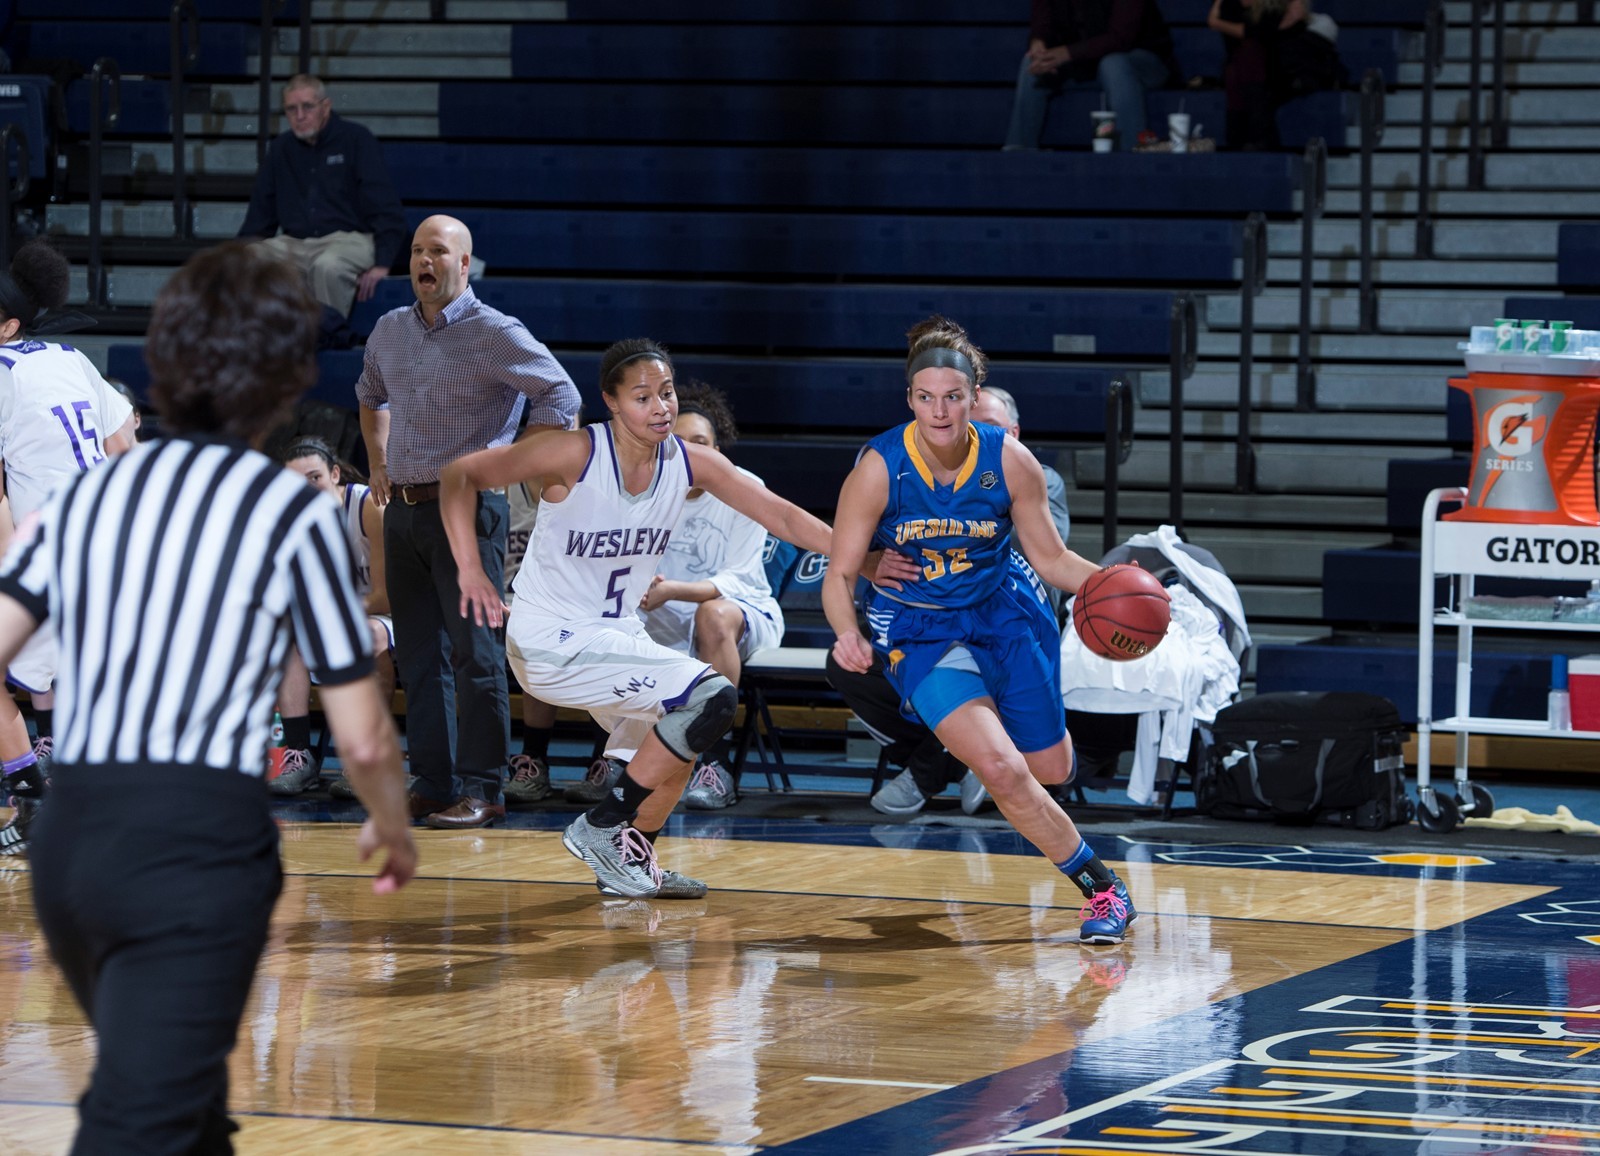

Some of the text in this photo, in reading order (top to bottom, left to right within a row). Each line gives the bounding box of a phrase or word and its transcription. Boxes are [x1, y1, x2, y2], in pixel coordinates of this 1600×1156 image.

[51, 400, 104, 471] 15
[1488, 402, 1533, 456] G
[1485, 458, 1534, 472] SERIES
[895, 518, 998, 545] URSULINE
[1486, 536, 1600, 566] GATOR
[601, 566, 632, 618] 5
[612, 676, 657, 698] KWC
